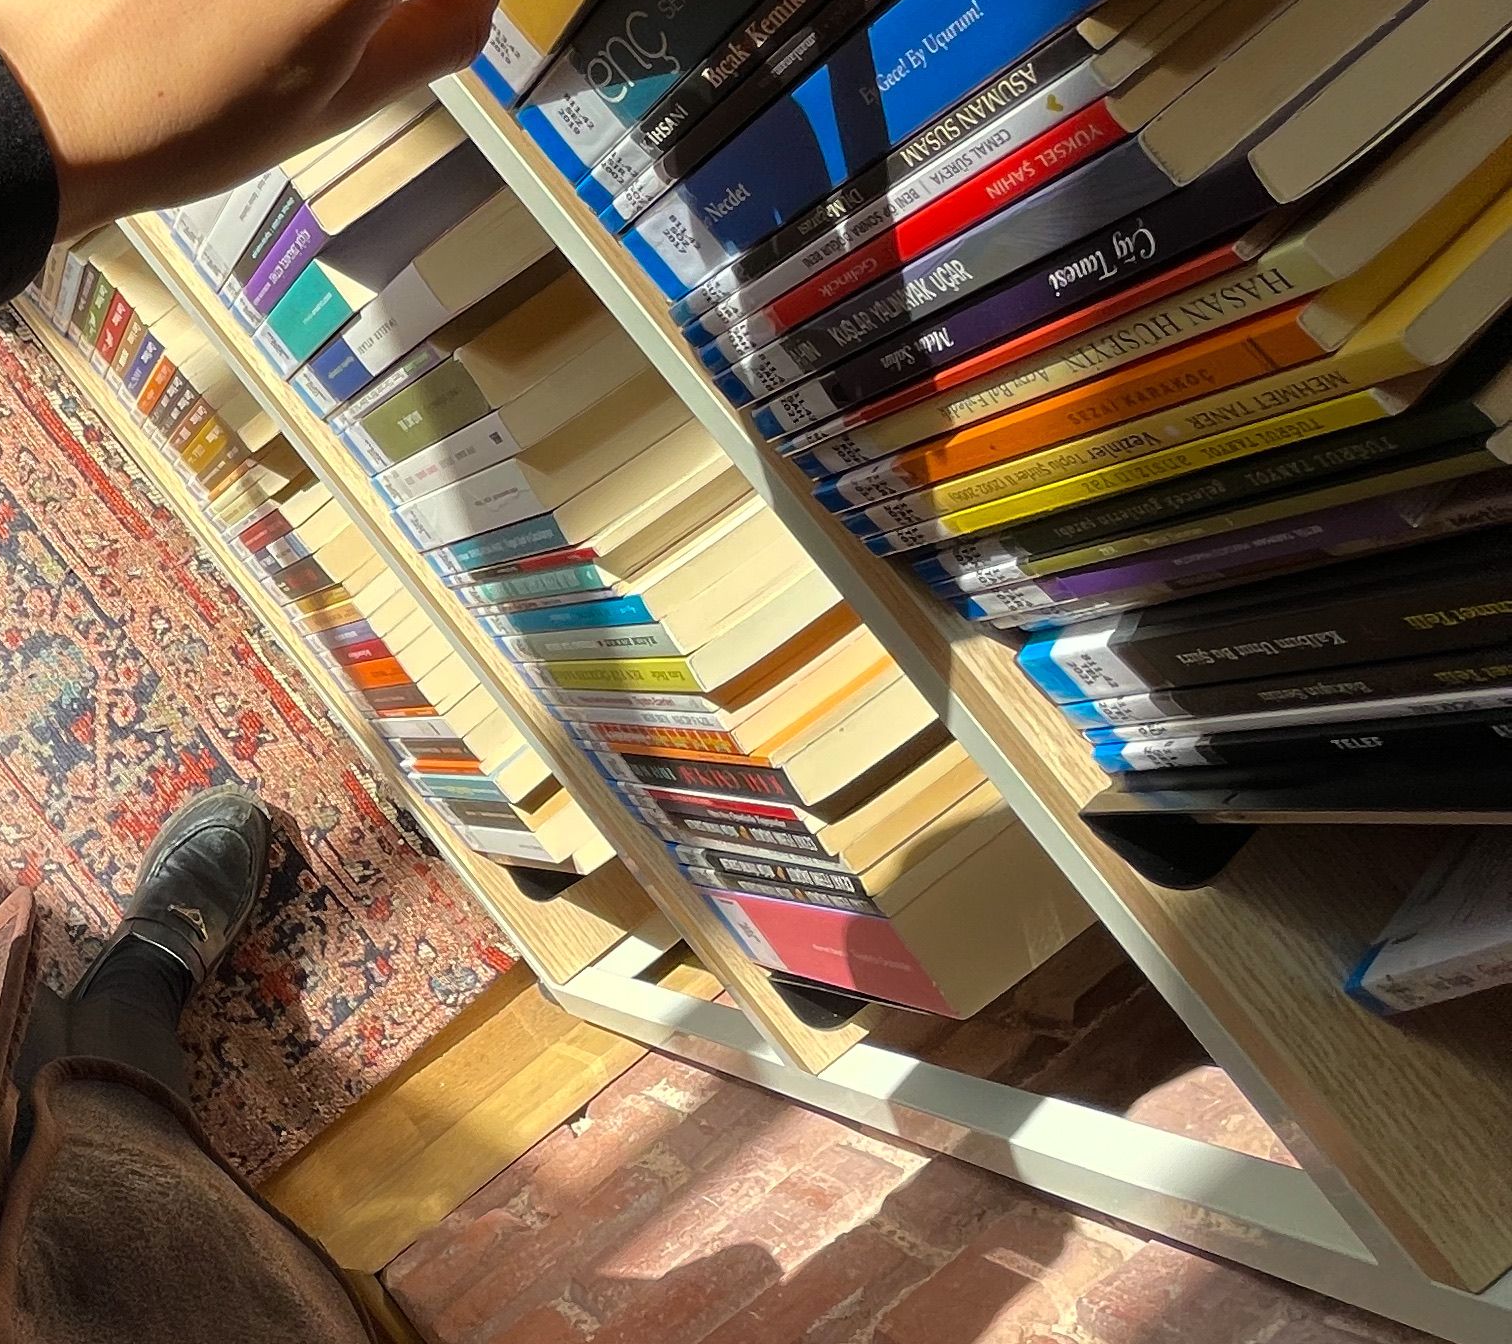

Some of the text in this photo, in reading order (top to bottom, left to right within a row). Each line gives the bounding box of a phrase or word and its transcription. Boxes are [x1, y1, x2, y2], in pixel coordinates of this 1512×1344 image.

[700, 40, 751, 89] Bıçak
[875, 61, 911, 93] Gece!
[904, 47, 928, 70] Ey
[899, 62, 1038, 168] ASUMAN SUSAM
[972, 128, 1012, 159] CEMAL
[929, 154, 974, 185] SÜREYA
[985, 124, 1104, 200] YÜKSEL ŞAHİN
[702, 182, 752, 224] Necdet
[893, 188, 921, 210] BENİ
[852, 209, 883, 238] SONRA
[1047, 216, 1157, 298] Çiğ Tanesi
[817, 256, 880, 299] Gelincik
[826, 310, 879, 349] KUŞLAR
[929, 258, 975, 293] UÇAR
[1179, 267, 1296, 328] HASAN
[1060, 311, 1184, 374] HÜSEYİN
[987, 379, 1015, 405] Bal
[1121, 367, 1214, 407] KARAKOÇ
[1253, 369, 1350, 406] MEHMET
[1187, 400, 1254, 432] TANER
[1087, 429, 1162, 462] Vezinler
[1314, 435, 1400, 468] TUĞRUL
[1049, 451, 1088, 475] Toplu
[1114, 454, 1194, 485] ansızın
[1080, 471, 1115, 496] yaz
[1167, 478, 1227, 506] gelecek
[1097, 493, 1167, 528] günlerin
[1401, 611, 1458, 632] Telli
[1231, 639, 1278, 661] Unut
[1274, 629, 1349, 655] Kalbim
